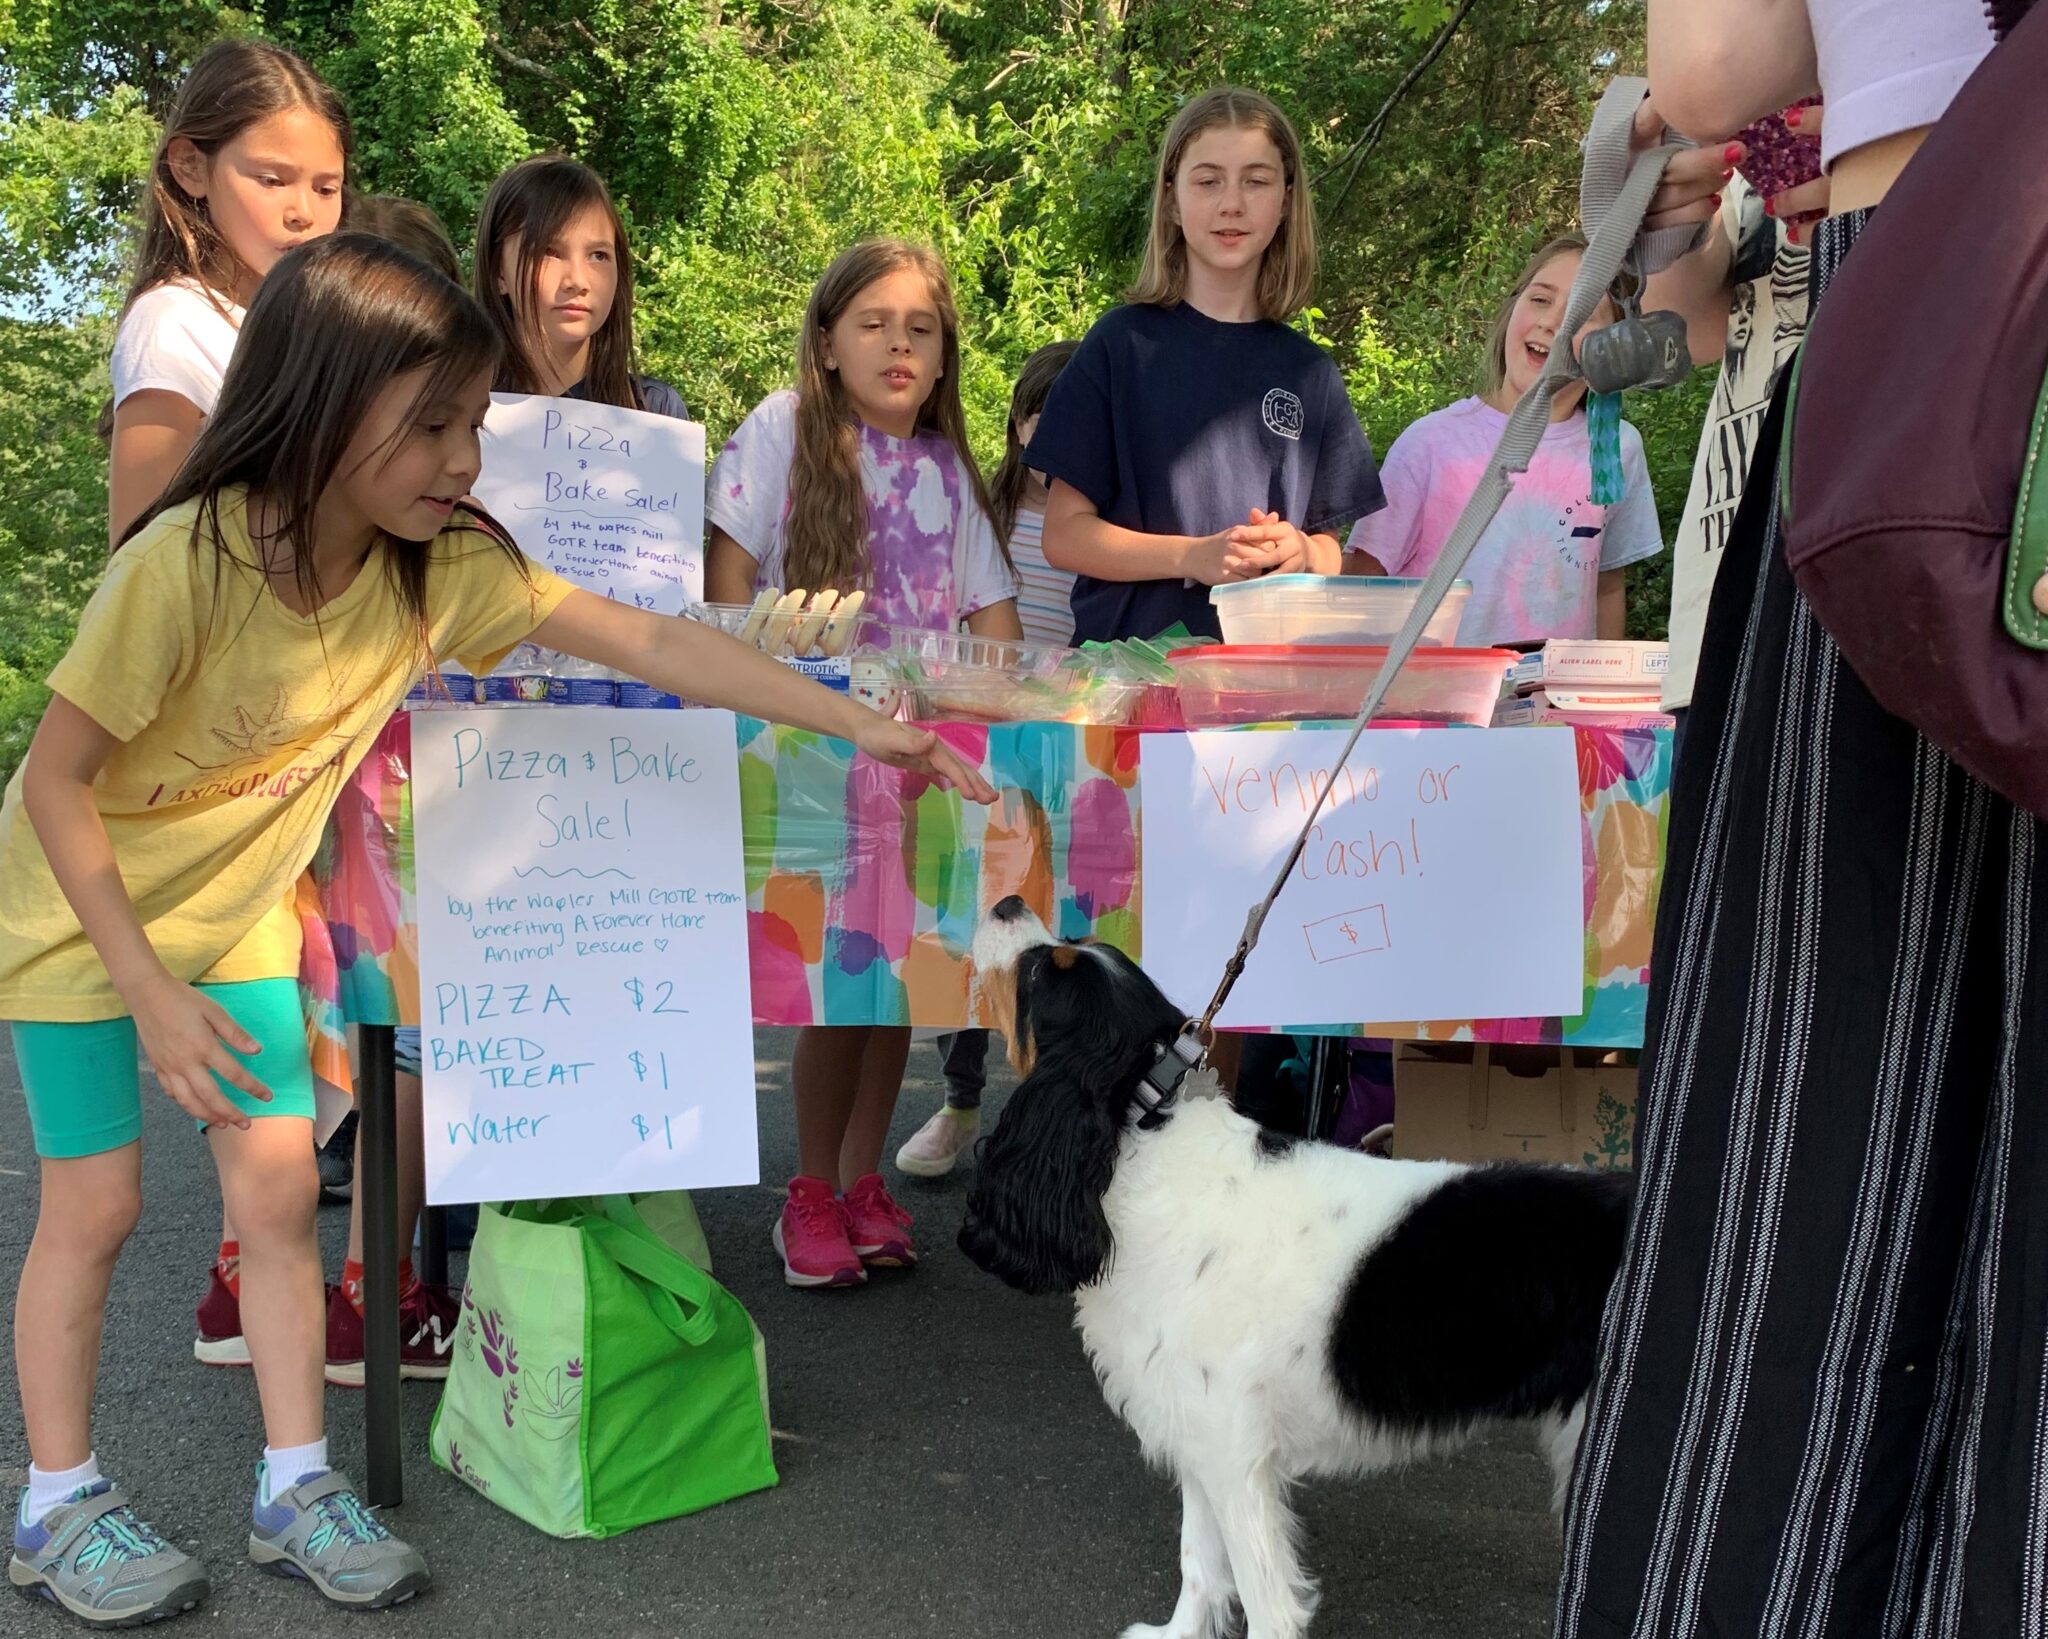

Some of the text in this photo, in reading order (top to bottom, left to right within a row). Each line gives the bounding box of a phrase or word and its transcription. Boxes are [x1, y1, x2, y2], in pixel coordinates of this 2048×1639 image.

[543, 409, 631, 458] Pizza
[545, 471, 678, 512] Bake Sale!
[543, 517, 560, 531] by
[570, 520, 592, 531] the
[546, 550, 555, 560] A
[649, 568, 684, 584] animal
[547, 534, 696, 573] GOTR team benefiting
[1645, 659, 1668, 668] LEFT
[453, 728, 567, 788] Pizza
[609, 736, 702, 785] Bake
[1202, 756, 1461, 815] Venmo or
[536, 794, 632, 853] Sale!
[1302, 817, 1425, 880] Cash!
[446, 895, 473, 921] by
[485, 896, 516, 914] the
[609, 888, 641, 905] Mill
[648, 887, 697, 905] GOTR
[704, 890, 743, 904] team
[472, 911, 707, 947] benefiting A Forever Home
[484, 938, 645, 964] Animal Rescue
[435, 981, 572, 1026] PIZZA
[430, 1036, 545, 1072] BAKED
[479, 1061, 597, 1089] TREAT
